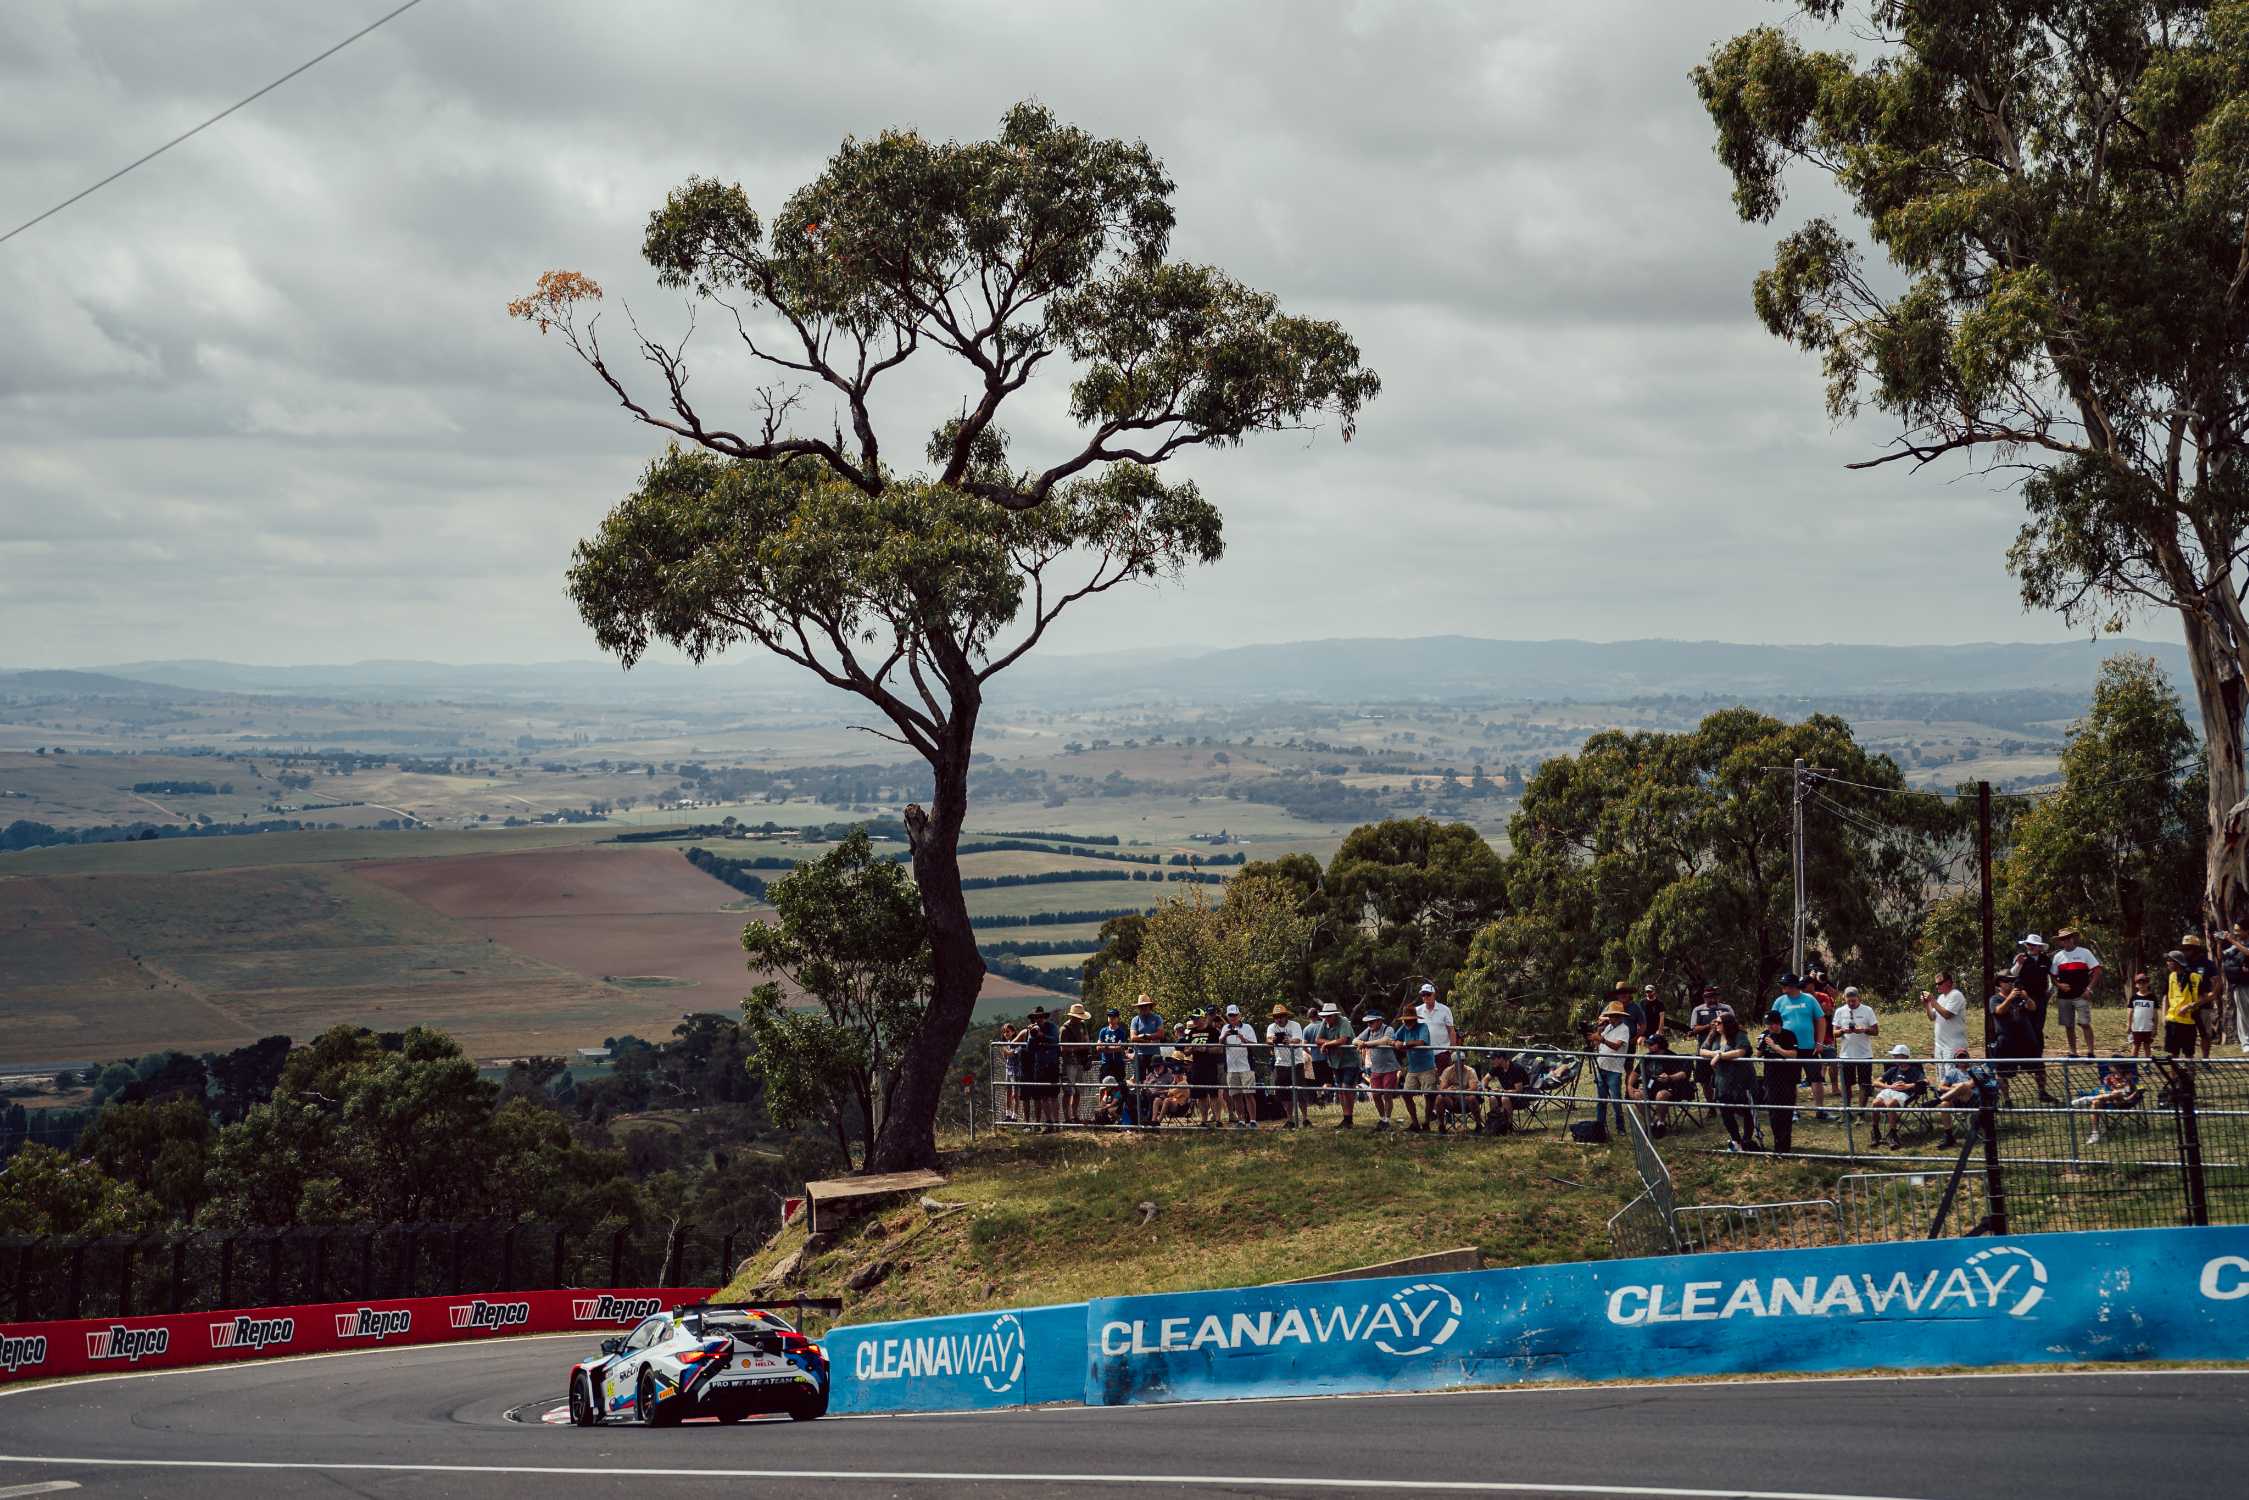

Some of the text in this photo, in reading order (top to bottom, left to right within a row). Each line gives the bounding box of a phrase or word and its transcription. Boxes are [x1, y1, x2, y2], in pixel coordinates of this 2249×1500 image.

[595, 1295, 662, 1323] Repco
[1606, 1264, 2021, 1325] CLEANAWAY
[233, 1316, 295, 1350] Repco
[355, 1308, 412, 1339] Repco
[470, 1300, 529, 1331] Repco
[1101, 1299, 1440, 1356] CLEANAWAY
[108, 1325, 169, 1361] Repco
[856, 1332, 1015, 1381] CLEANAWAY
